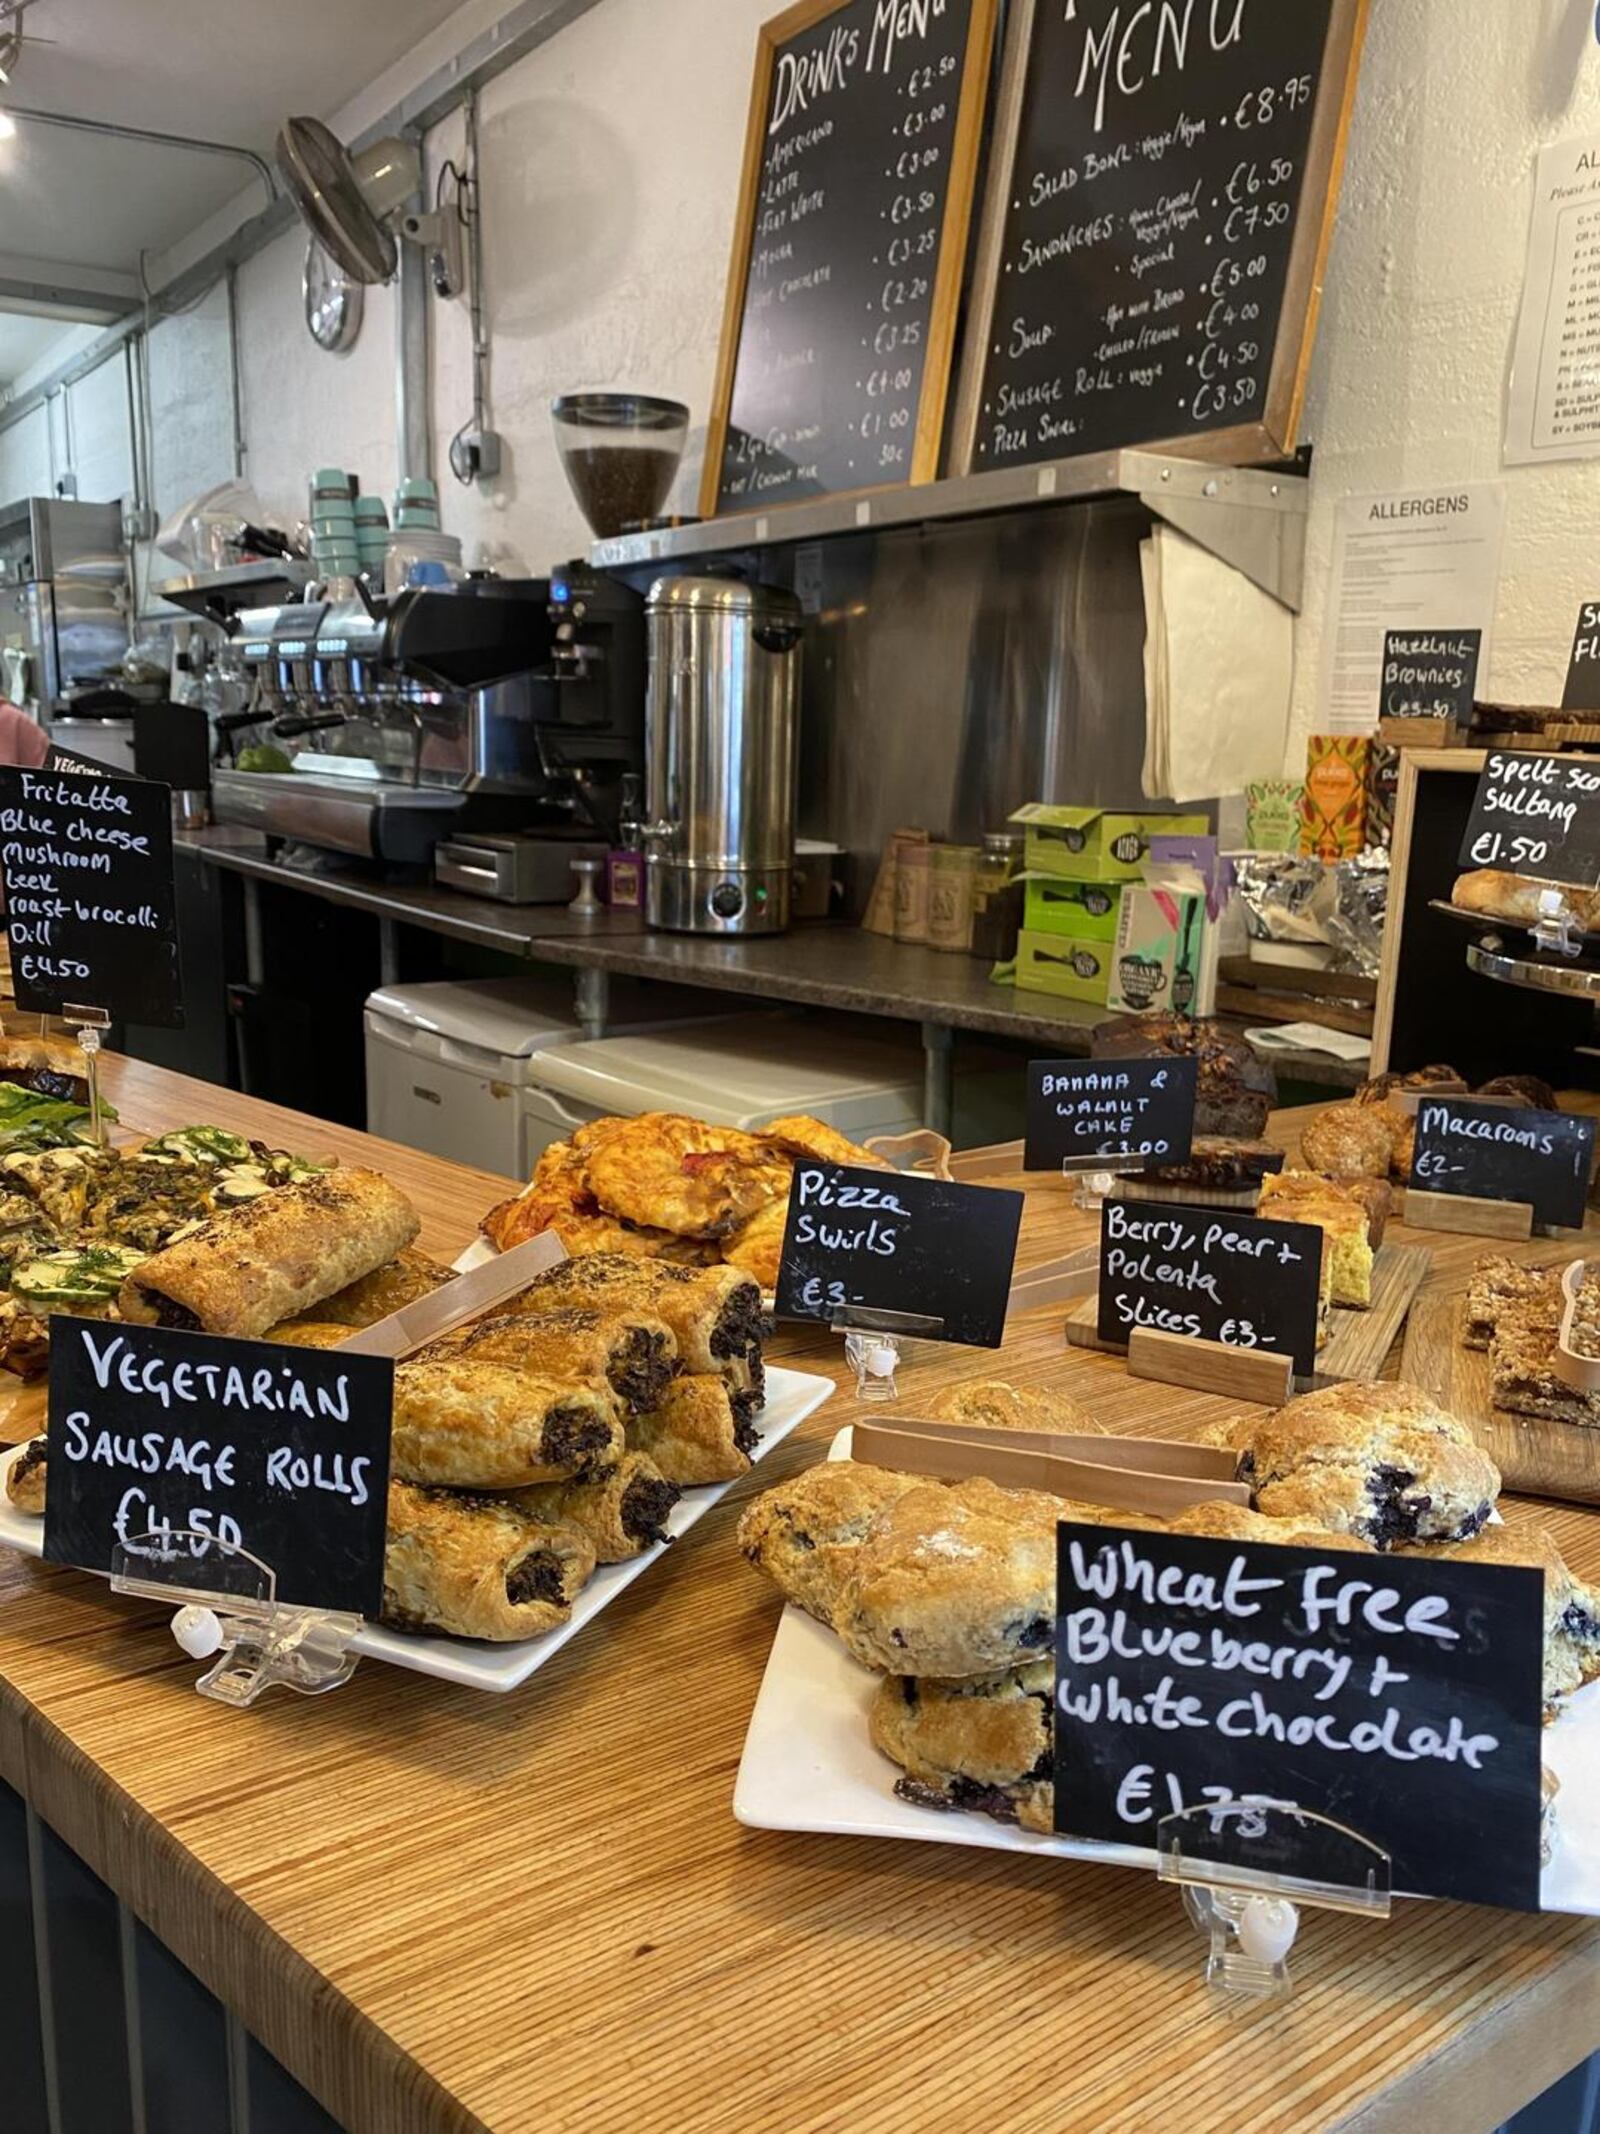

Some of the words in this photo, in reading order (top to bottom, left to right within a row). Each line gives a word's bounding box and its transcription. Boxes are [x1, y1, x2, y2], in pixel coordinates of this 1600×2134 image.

[1235, 74, 1312, 130] €8.95
[1368, 495, 1469, 521] ALLERGENS
[1387, 634, 1475, 659] Hazelnut
[1384, 661, 1463, 688] Brownies
[1488, 754, 1562, 785] Spelt
[1470, 831, 1548, 864] €1.50
[11, 920, 52, 946] Dill
[21, 953, 91, 981] €4.50
[1041, 1072, 1130, 1096] BANANA
[1056, 1097, 1150, 1116] WALNUT
[1074, 1115, 1135, 1136] CAKE
[1422, 1105, 1554, 1156] Macaroons
[1096, 1139, 1170, 1156] €3.00
[799, 1169, 912, 1217] Pizza
[794, 1213, 897, 1256] Swirls
[64, 1411, 237, 1492] SAUSAGE
[266, 1446, 371, 1506] ROLLS
[111, 1486, 243, 1558] €4.50
[1069, 1539, 1286, 1618] Wheat
